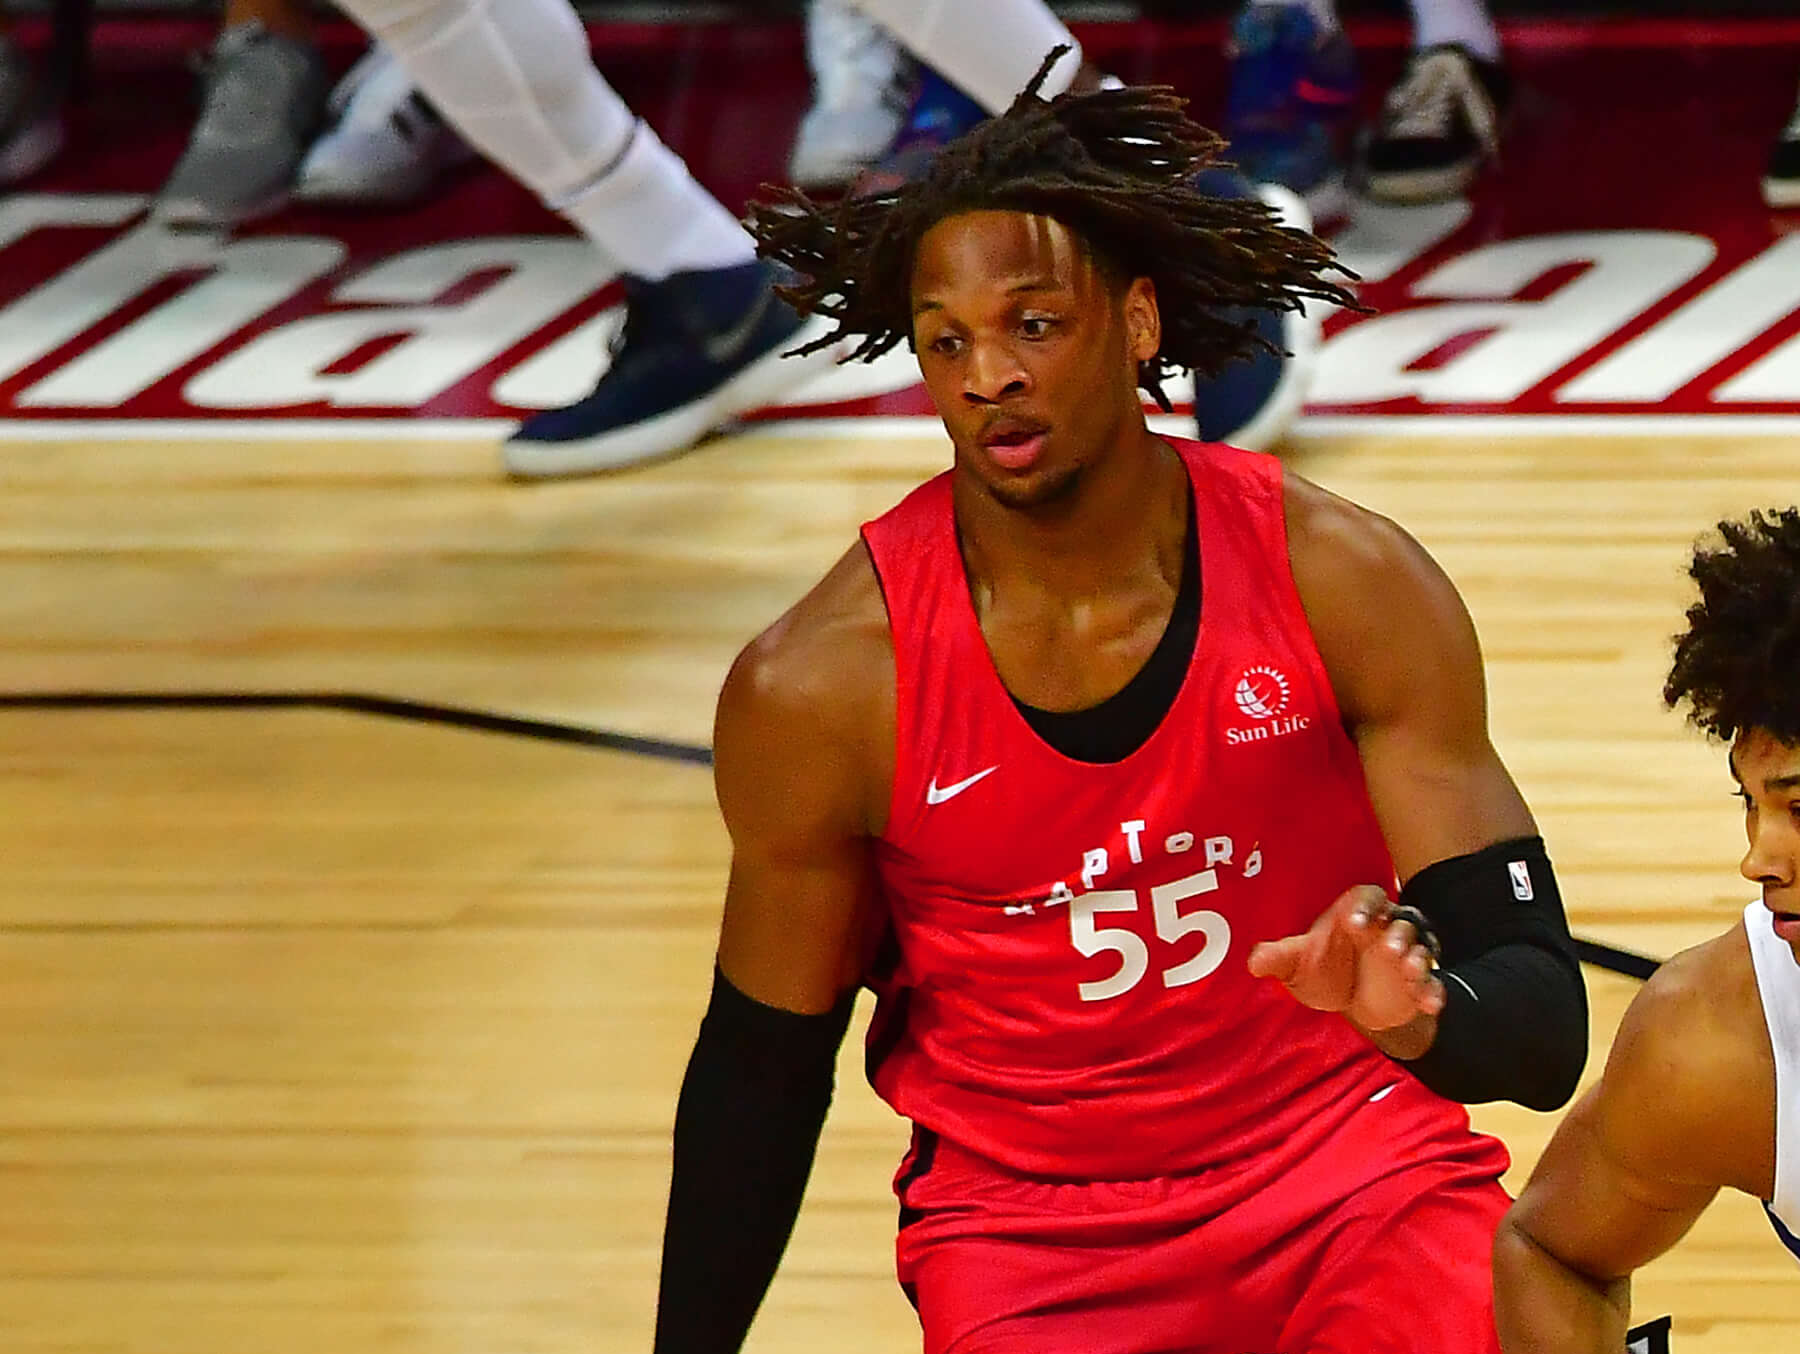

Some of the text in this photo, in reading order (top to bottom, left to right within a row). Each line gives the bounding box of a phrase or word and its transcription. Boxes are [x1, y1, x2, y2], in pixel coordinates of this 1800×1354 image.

[1226, 714, 1310, 745] Sun Life
[1069, 868, 1232, 1002] 55
